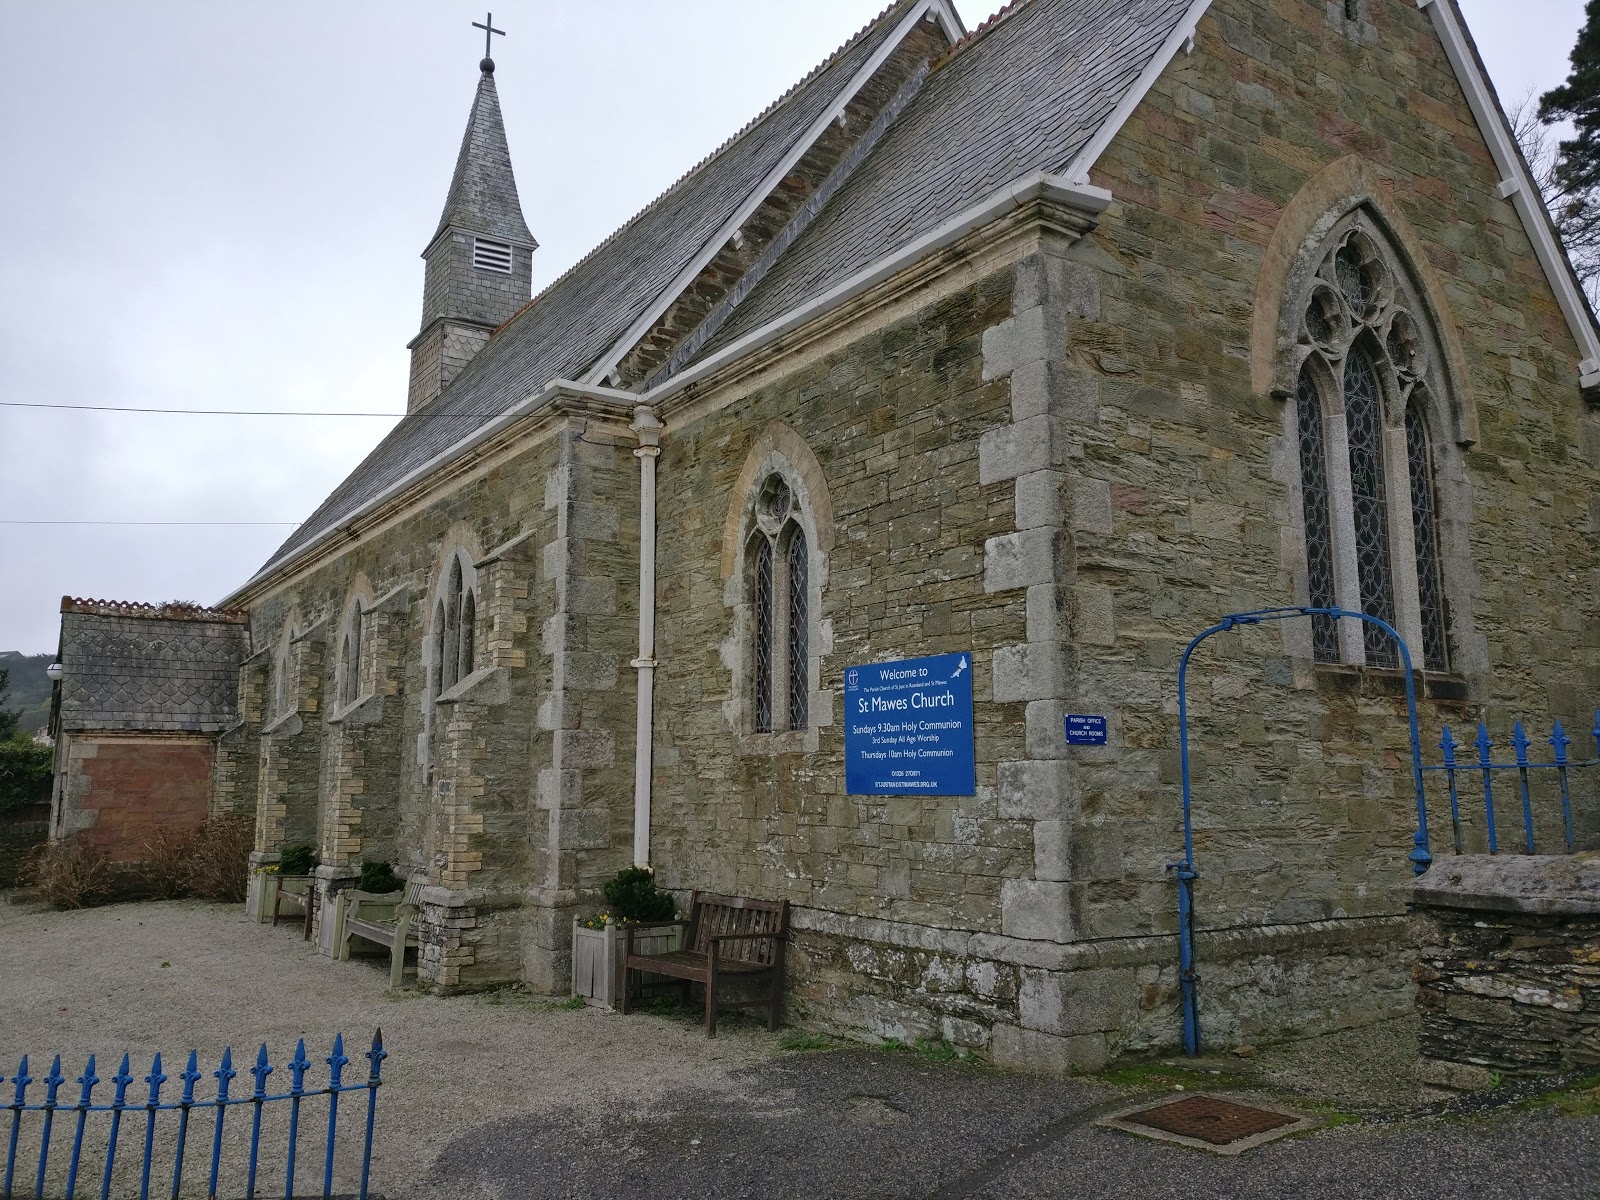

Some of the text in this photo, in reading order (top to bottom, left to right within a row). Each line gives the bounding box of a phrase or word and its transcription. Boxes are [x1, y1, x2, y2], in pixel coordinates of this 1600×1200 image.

[880, 668, 928, 681] Welcome to
[858, 690, 954, 713] St Mawes Church
[852, 720, 962, 735] Sundays 9.30am Holy Communion
[872, 736, 880, 744] 3rd
[881, 736, 897, 745] Sunday
[906, 735, 916, 745] Age
[916, 734, 940, 743] Worship
[860, 748, 954, 760] Thursdays 10am Holy Communion
